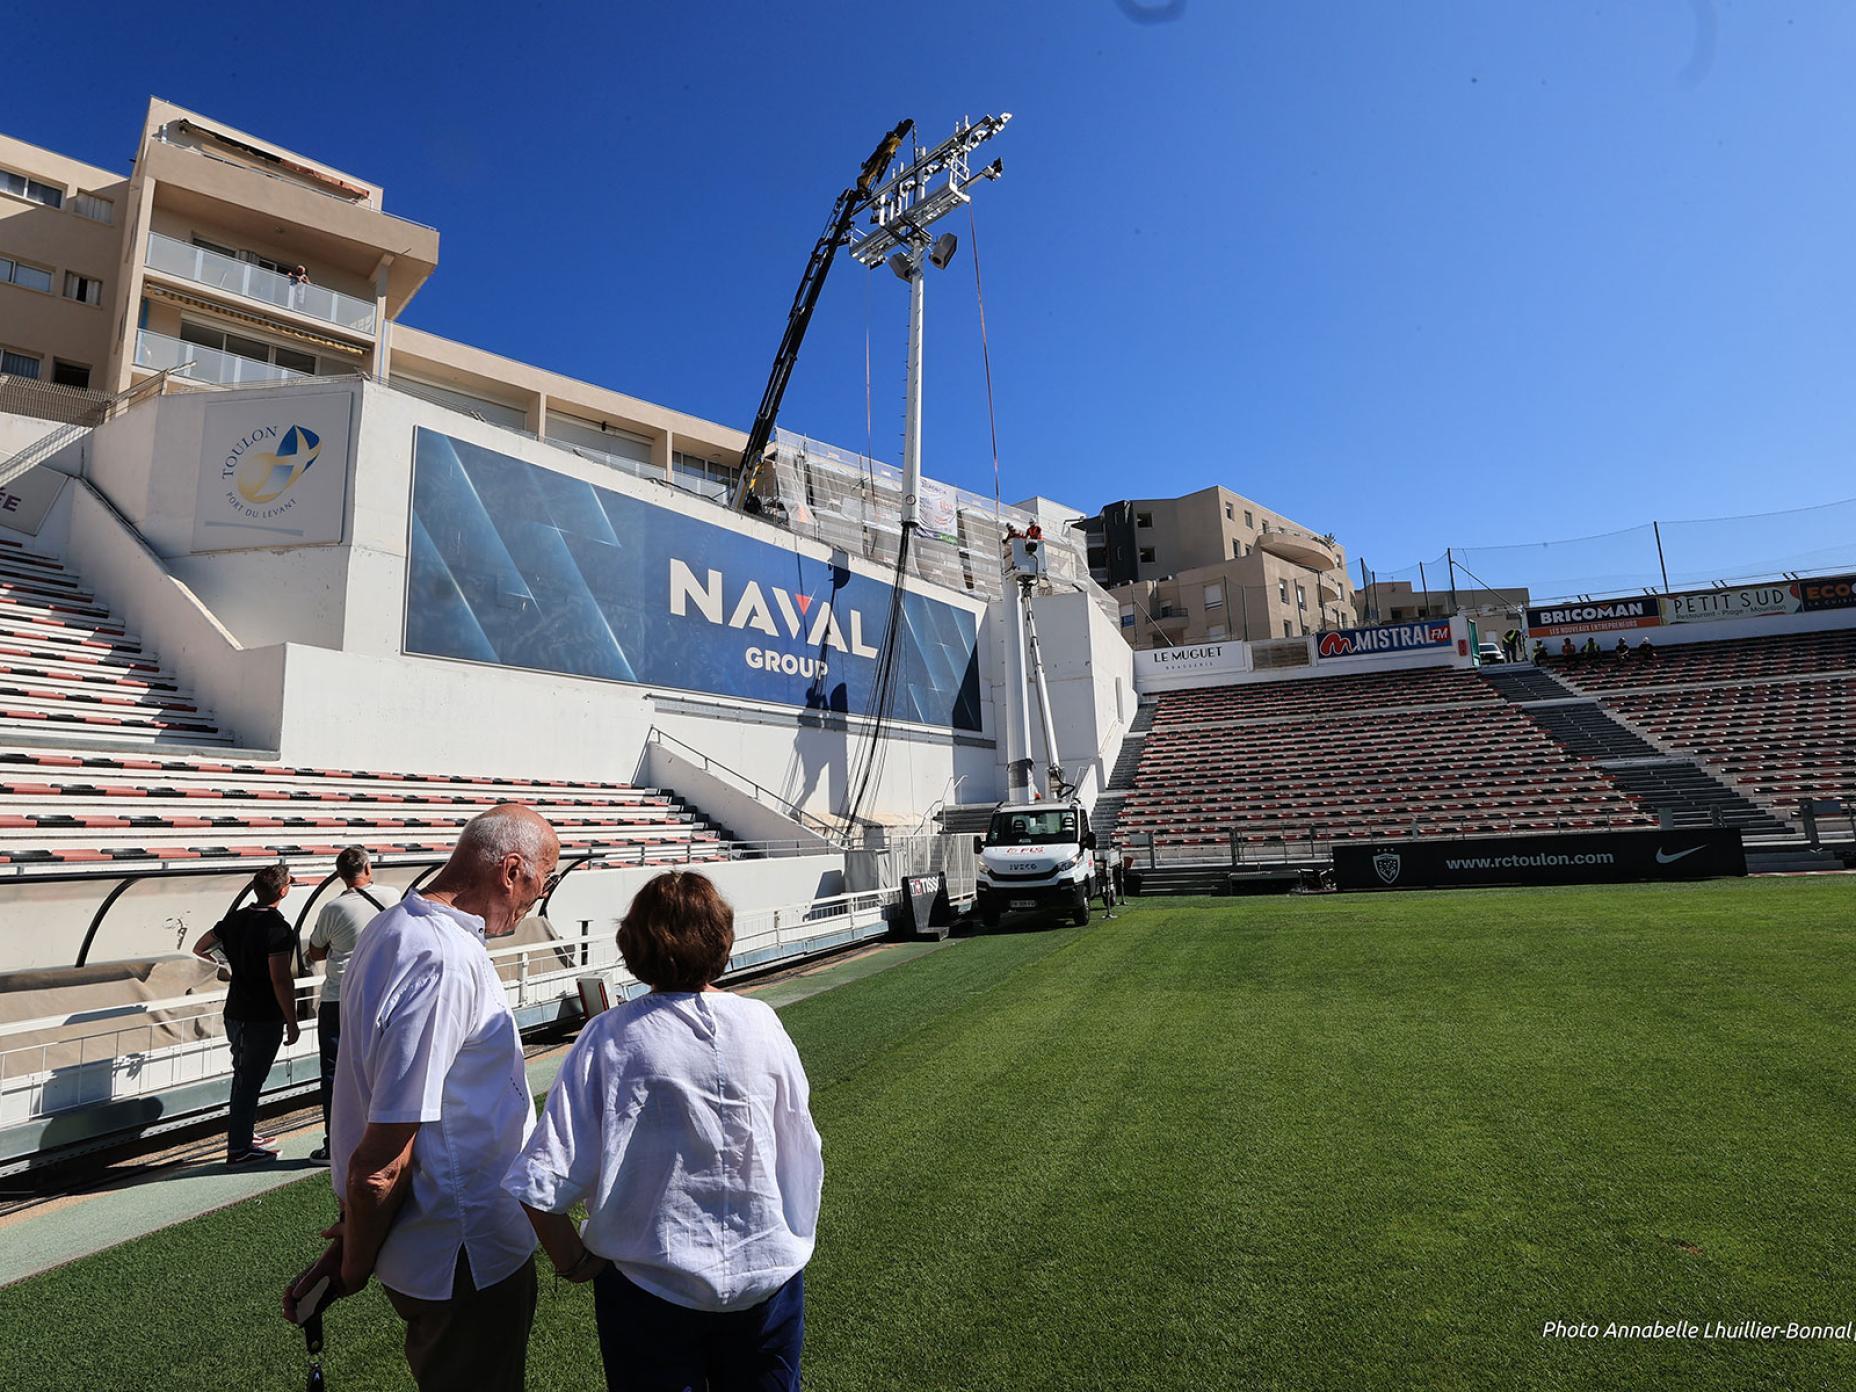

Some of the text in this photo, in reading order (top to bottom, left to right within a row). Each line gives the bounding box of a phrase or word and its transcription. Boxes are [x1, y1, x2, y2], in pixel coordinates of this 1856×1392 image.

[222, 425, 278, 480] TOULON
[226, 491, 297, 518] PORT DU LEVANT
[670, 558, 878, 659] NAVAL
[1540, 602, 1644, 625] BRICOMAN
[1674, 588, 1784, 614] PETIT SUD
[1354, 624, 1436, 652] MISTRAL
[1430, 628, 1448, 640] FM
[745, 647, 828, 680] GROUP
[1153, 646, 1222, 663] LE MUGUET
[1009, 863, 1037, 871] IVECO
[1446, 853, 1614, 869] www.rctoulon.com
